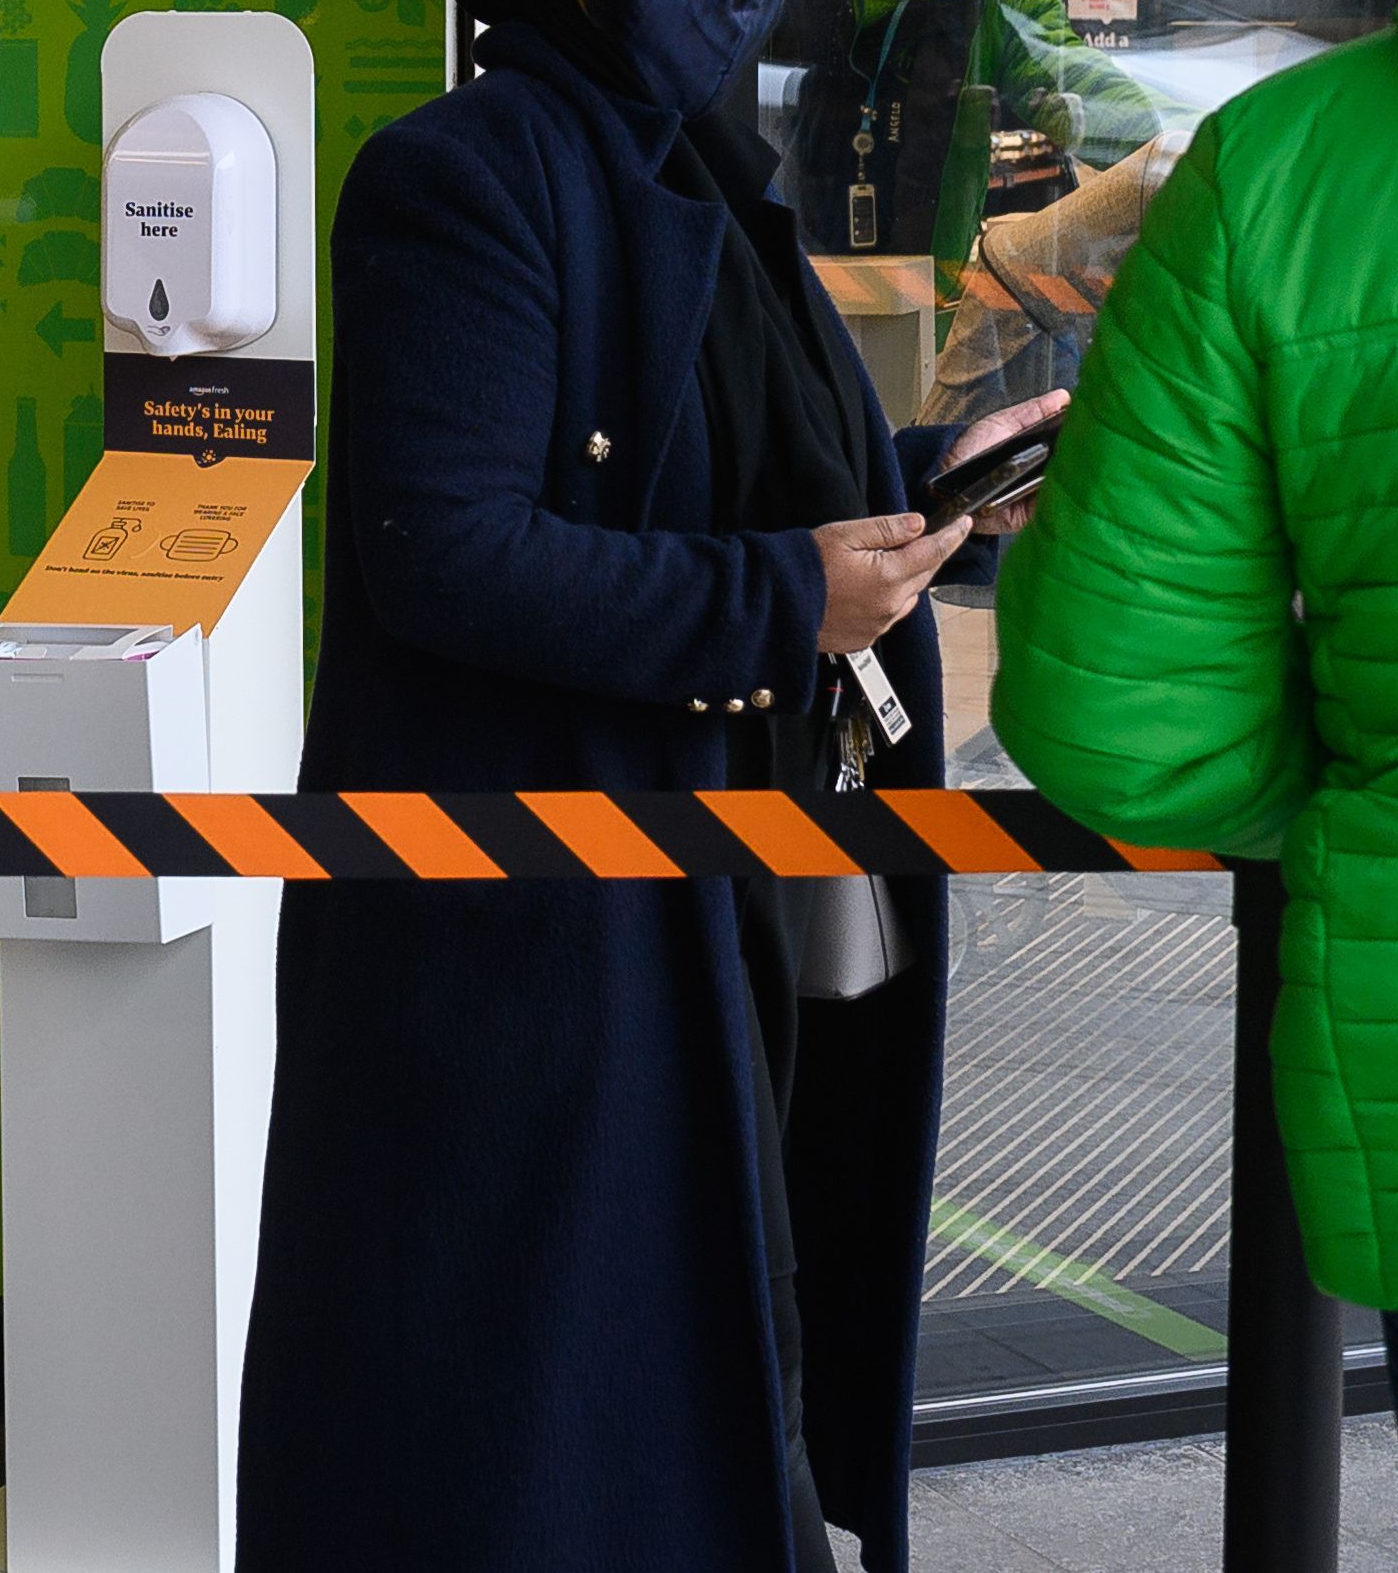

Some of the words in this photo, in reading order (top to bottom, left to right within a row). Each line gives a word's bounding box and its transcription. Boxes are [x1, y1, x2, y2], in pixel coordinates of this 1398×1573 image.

[1083, 31, 1115, 48] Add
[1118, 35, 1130, 48] a
[125, 201, 194, 218] Sanitise
[141, 222, 178, 237] here
[211, 385, 229, 394] fresh
[144, 400, 210, 420] Safety's
[214, 403, 231, 419] in
[235, 408, 275, 423] your
[152, 420, 208, 441] hands,
[213, 423, 267, 444] Ealing
